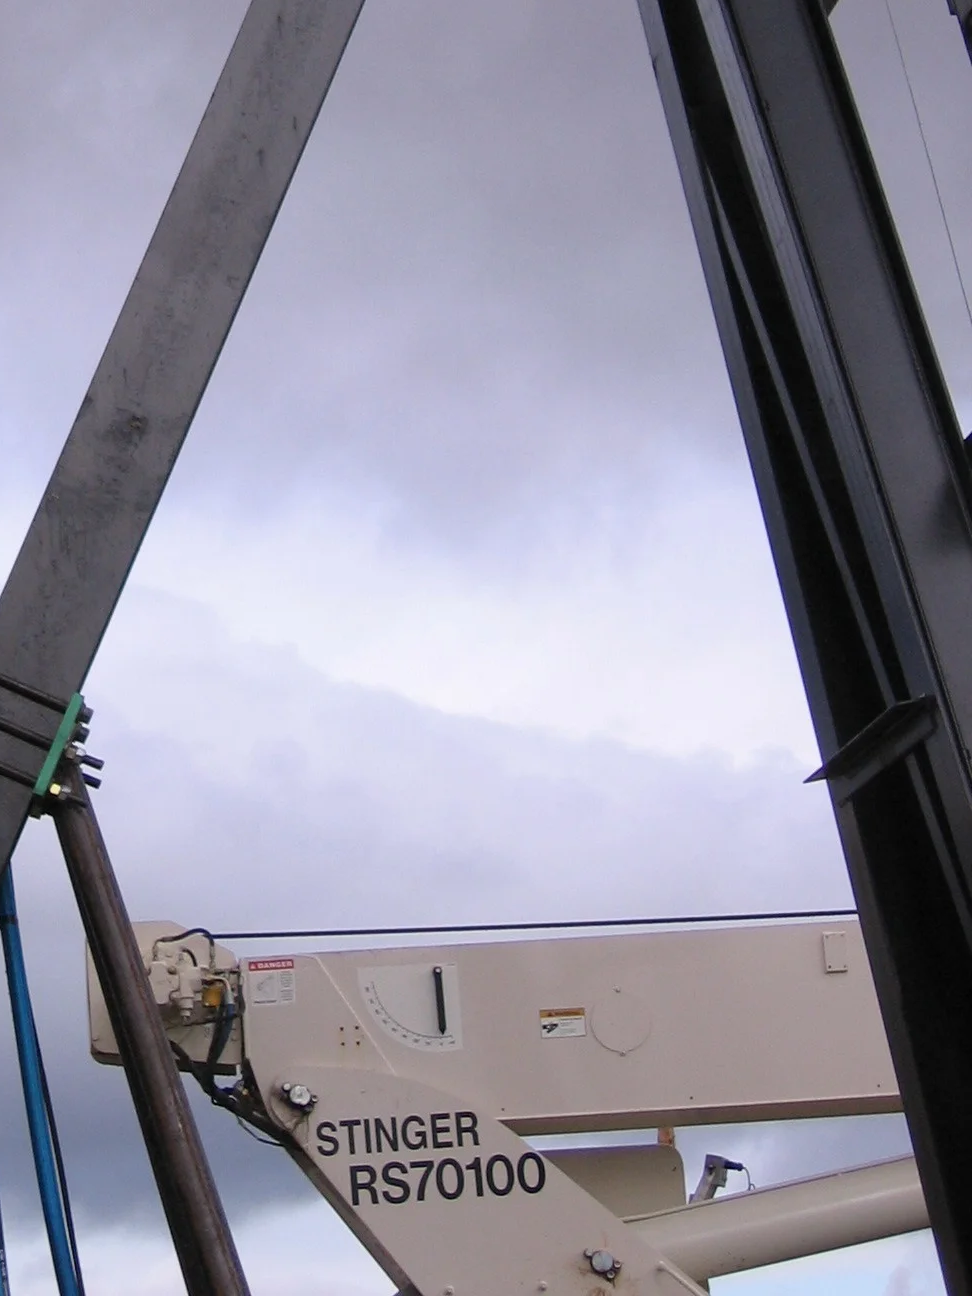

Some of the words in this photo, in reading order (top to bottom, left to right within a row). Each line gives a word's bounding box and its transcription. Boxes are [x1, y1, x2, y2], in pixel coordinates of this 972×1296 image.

[257, 960, 293, 969] DANGER
[316, 1111, 480, 1156] STINGER
[349, 1152, 546, 1206] RS70100
